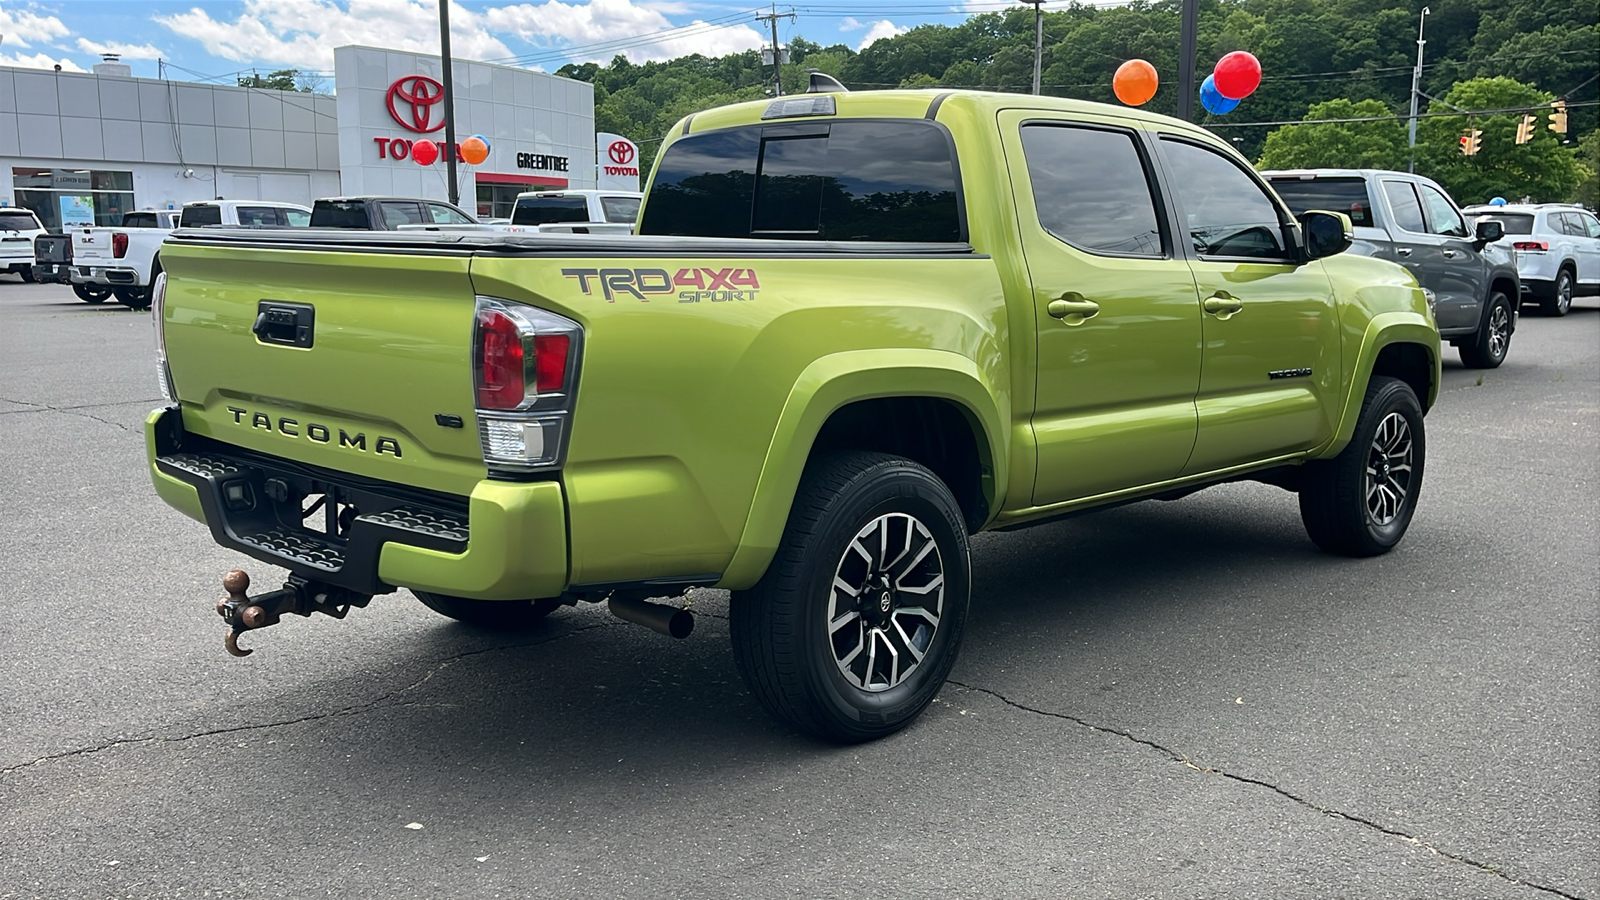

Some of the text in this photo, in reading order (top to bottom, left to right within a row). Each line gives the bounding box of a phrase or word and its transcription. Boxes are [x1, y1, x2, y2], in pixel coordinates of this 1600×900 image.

[516, 152, 569, 172] GREENTREE
[604, 166, 639, 177] TOYOTA
[561, 268, 675, 303] TRD
[678, 289, 760, 304] SPORT
[227, 406, 403, 459] TACOMA
